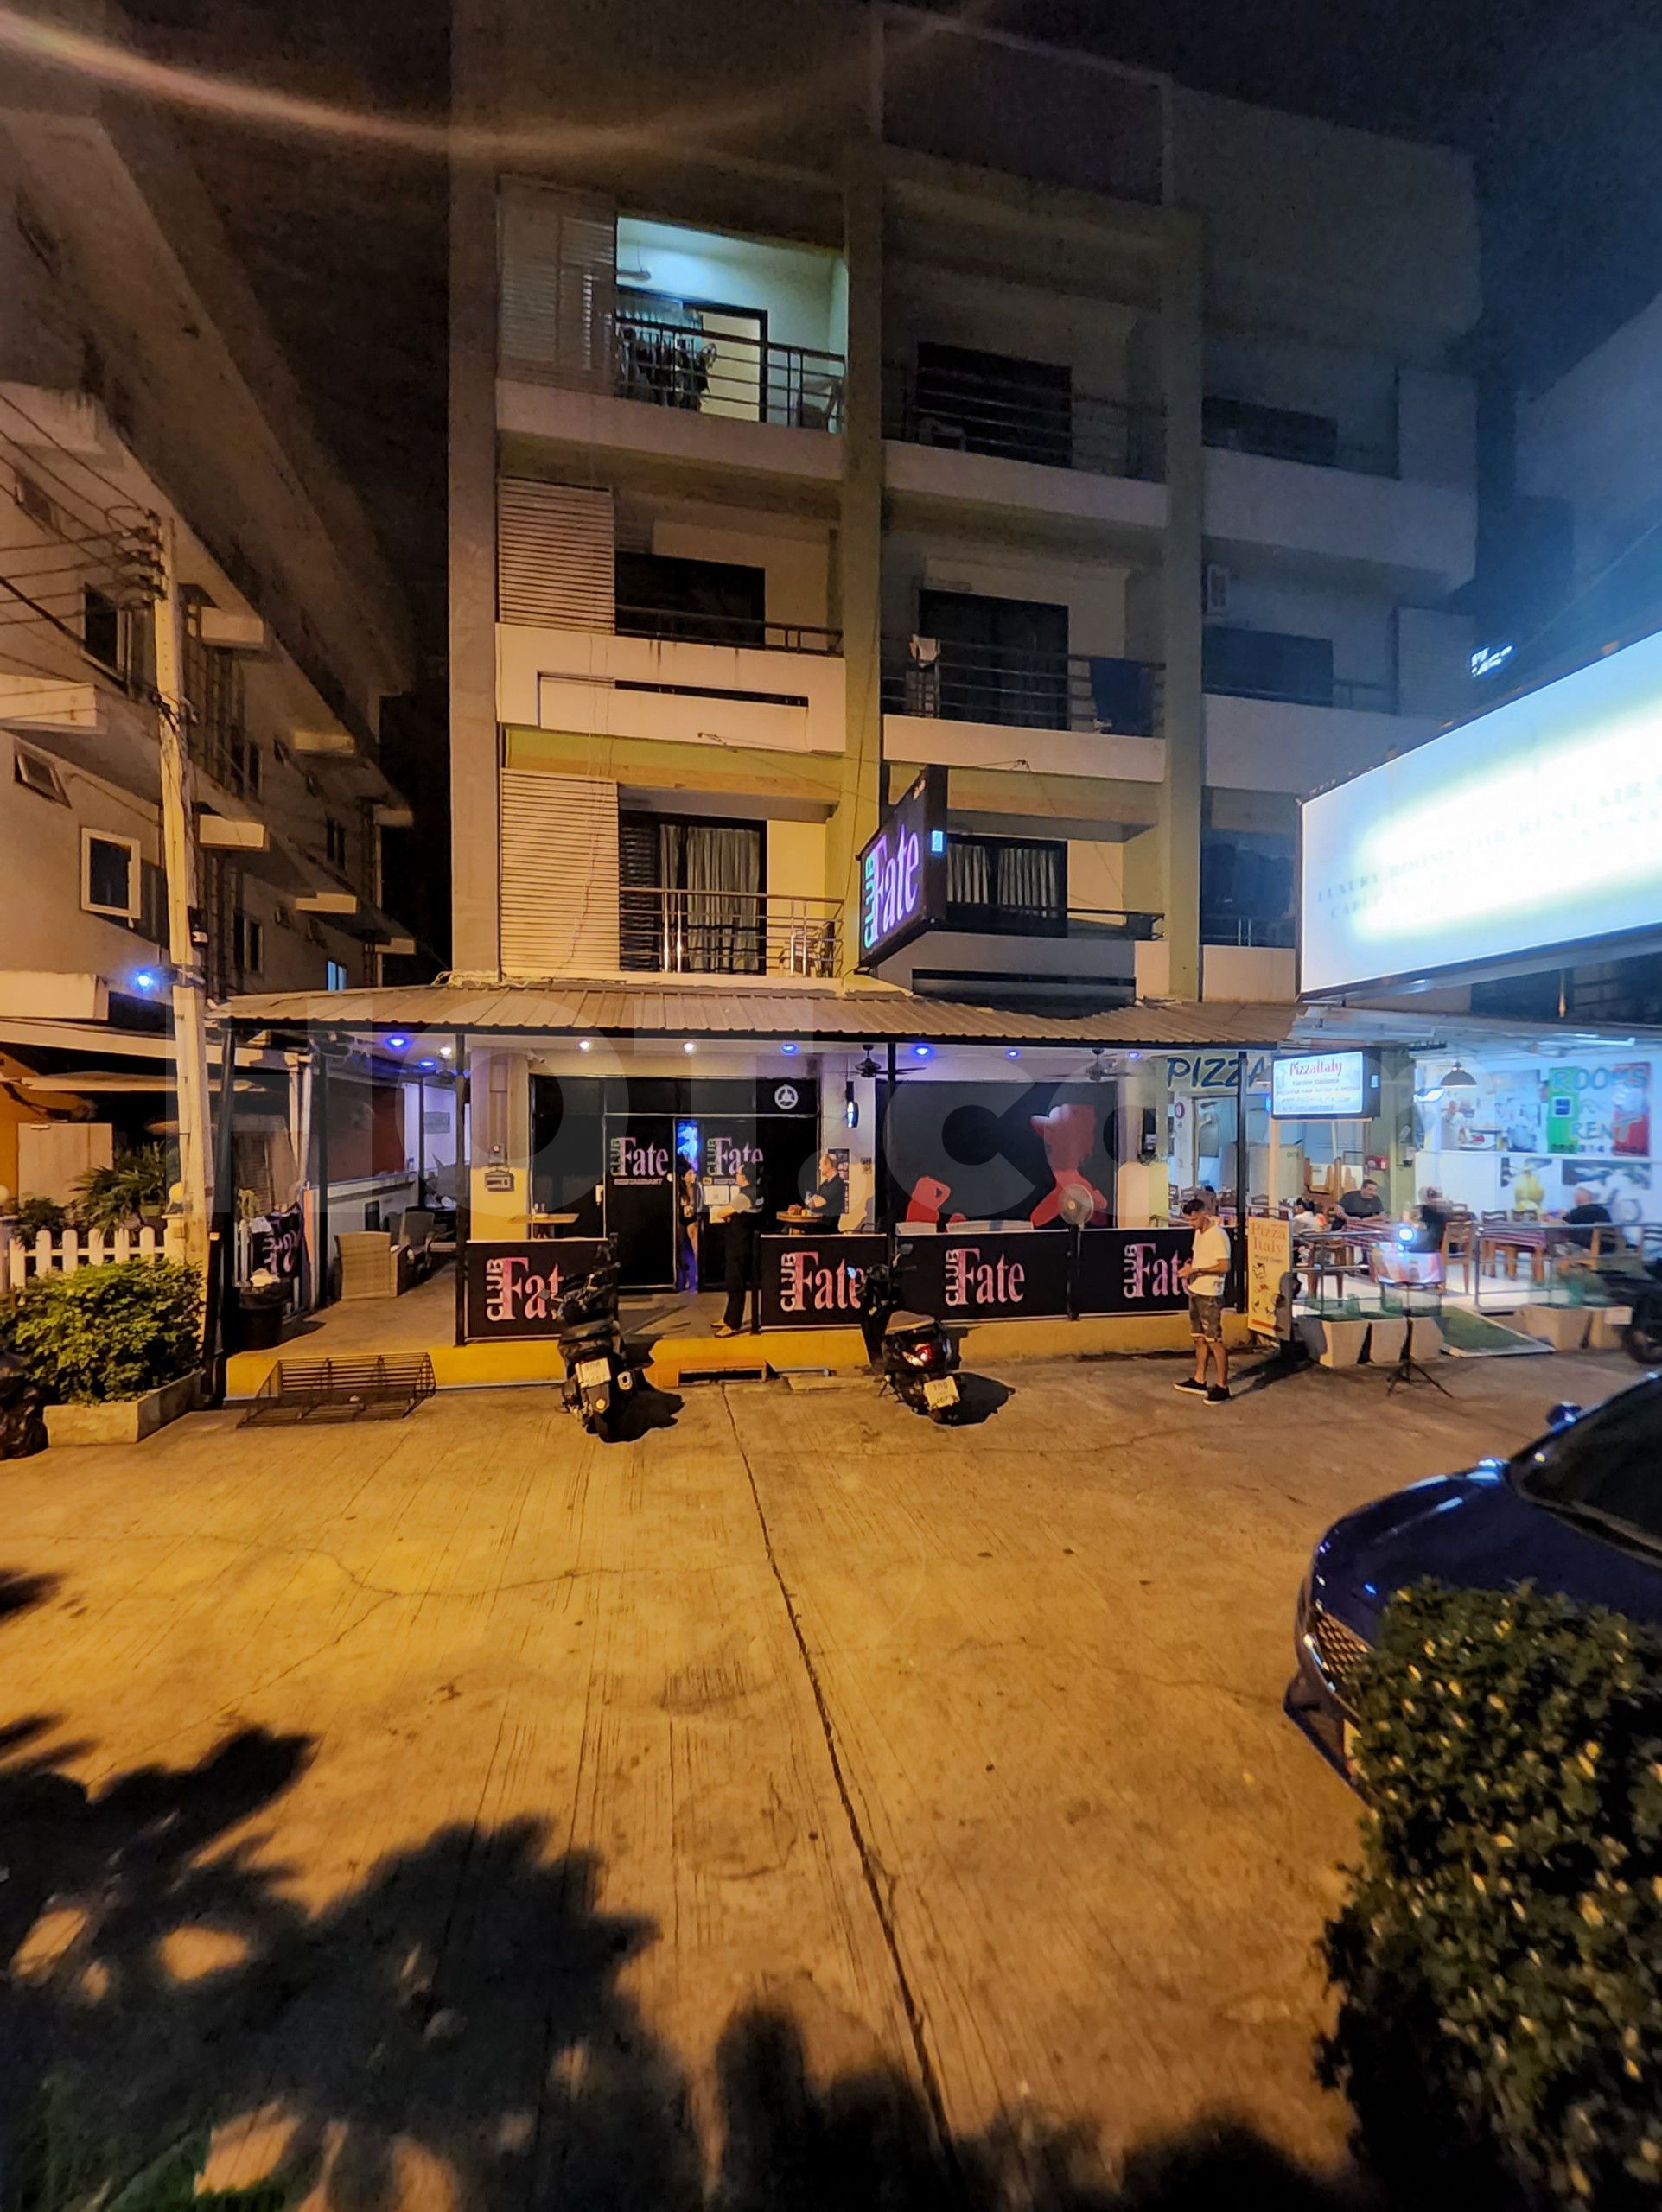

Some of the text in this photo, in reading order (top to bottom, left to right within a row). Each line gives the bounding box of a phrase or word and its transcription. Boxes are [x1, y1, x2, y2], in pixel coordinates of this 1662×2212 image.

[865, 855, 876, 948] CLUB
[872, 823, 919, 944] Fate
[1168, 1057, 1264, 1088] PIZZA
[619, 1136, 669, 1176] Fate
[1251, 1222, 1286, 1240] Pizza
[1254, 1236, 1283, 1256] Italy
[486, 1258, 504, 1321] CLUB
[502, 1256, 565, 1320] Fat
[780, 1252, 796, 1312] CLUB
[794, 1251, 865, 1311] Fate
[945, 1249, 960, 1306] CLUB
[958, 1248, 1025, 1305] Fate
[1123, 1244, 1137, 1299] CLUB
